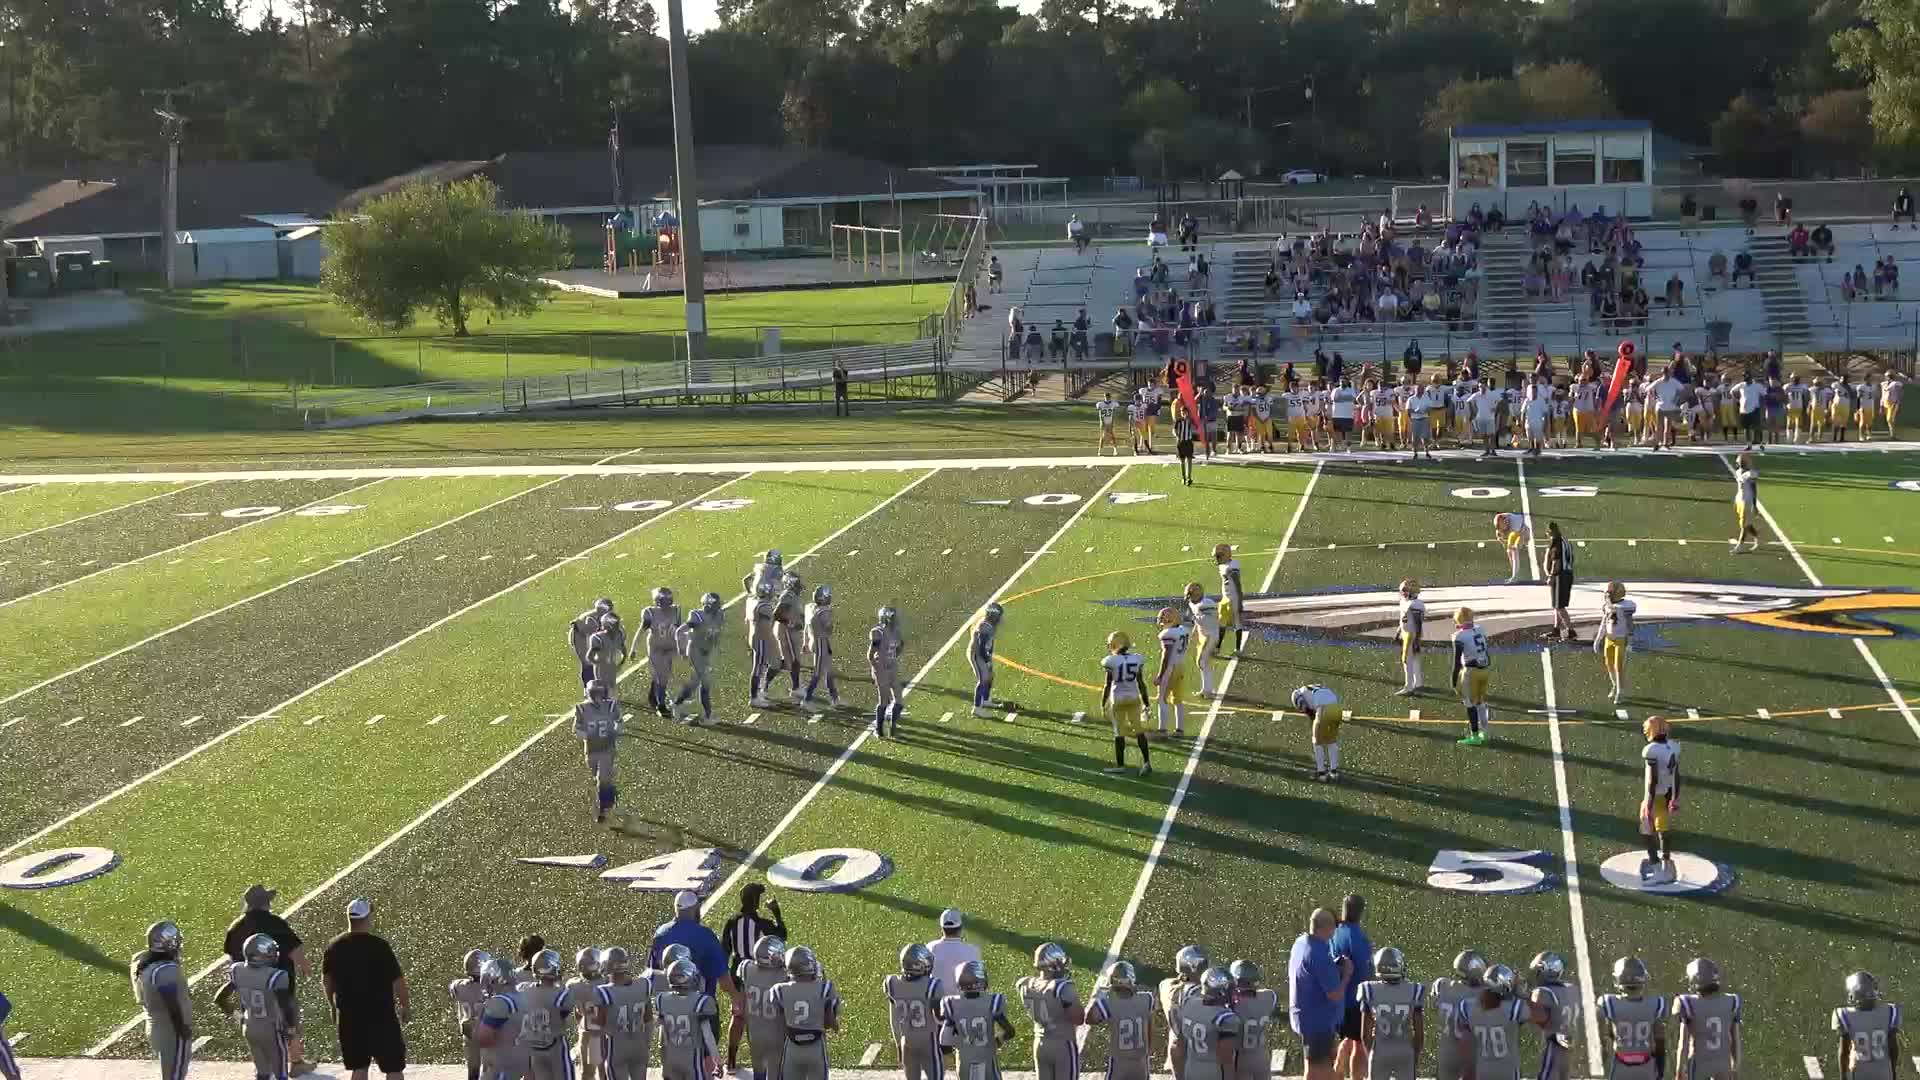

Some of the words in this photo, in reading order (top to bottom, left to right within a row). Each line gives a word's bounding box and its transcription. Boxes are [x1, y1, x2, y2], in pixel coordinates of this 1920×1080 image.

[1473, 633, 1486, 654] 5
[1116, 662, 1138, 683] 15
[793, 1000, 810, 1025] 2
[1118, 1015, 1146, 1050] 21
[1705, 1016, 1722, 1050] 3
